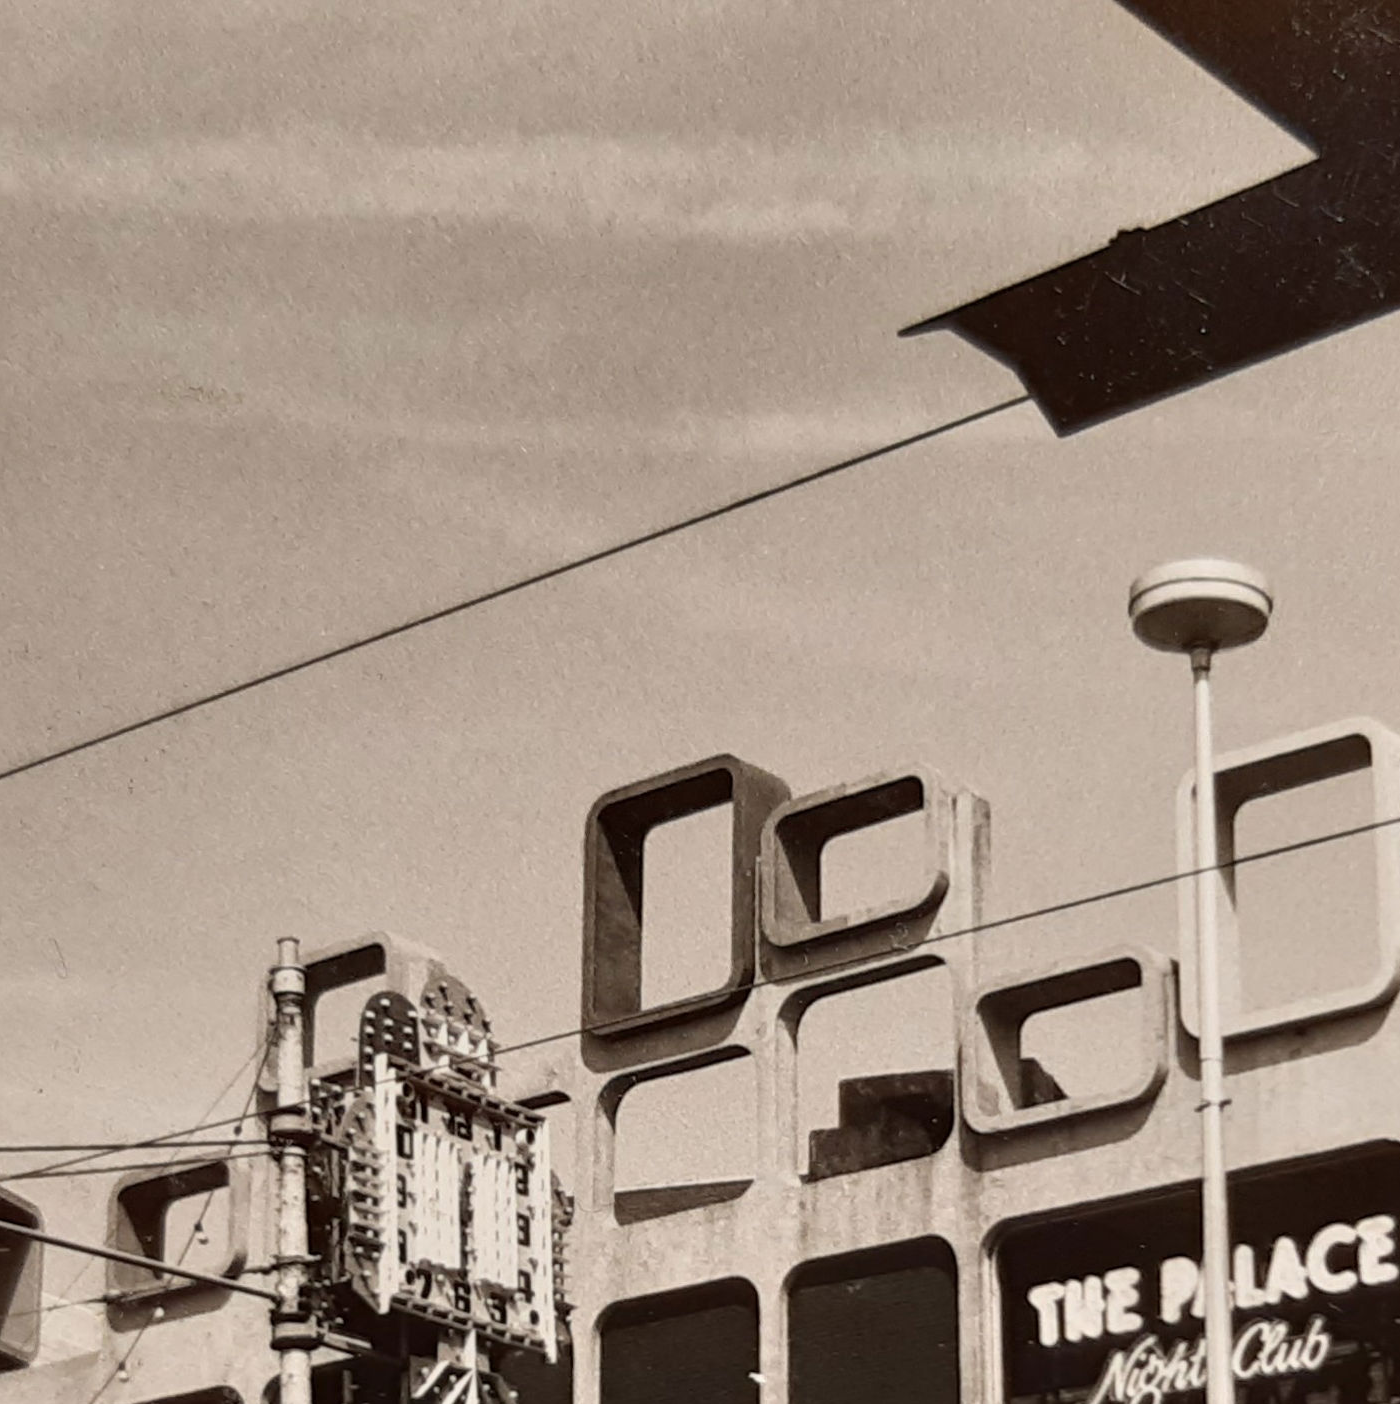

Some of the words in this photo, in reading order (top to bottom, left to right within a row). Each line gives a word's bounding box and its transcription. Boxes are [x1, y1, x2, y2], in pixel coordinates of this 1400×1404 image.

[1027, 1266, 1142, 1348] THE
[1158, 1214, 1400, 1325] PLACE
[1231, 1314, 1330, 1381] Club
